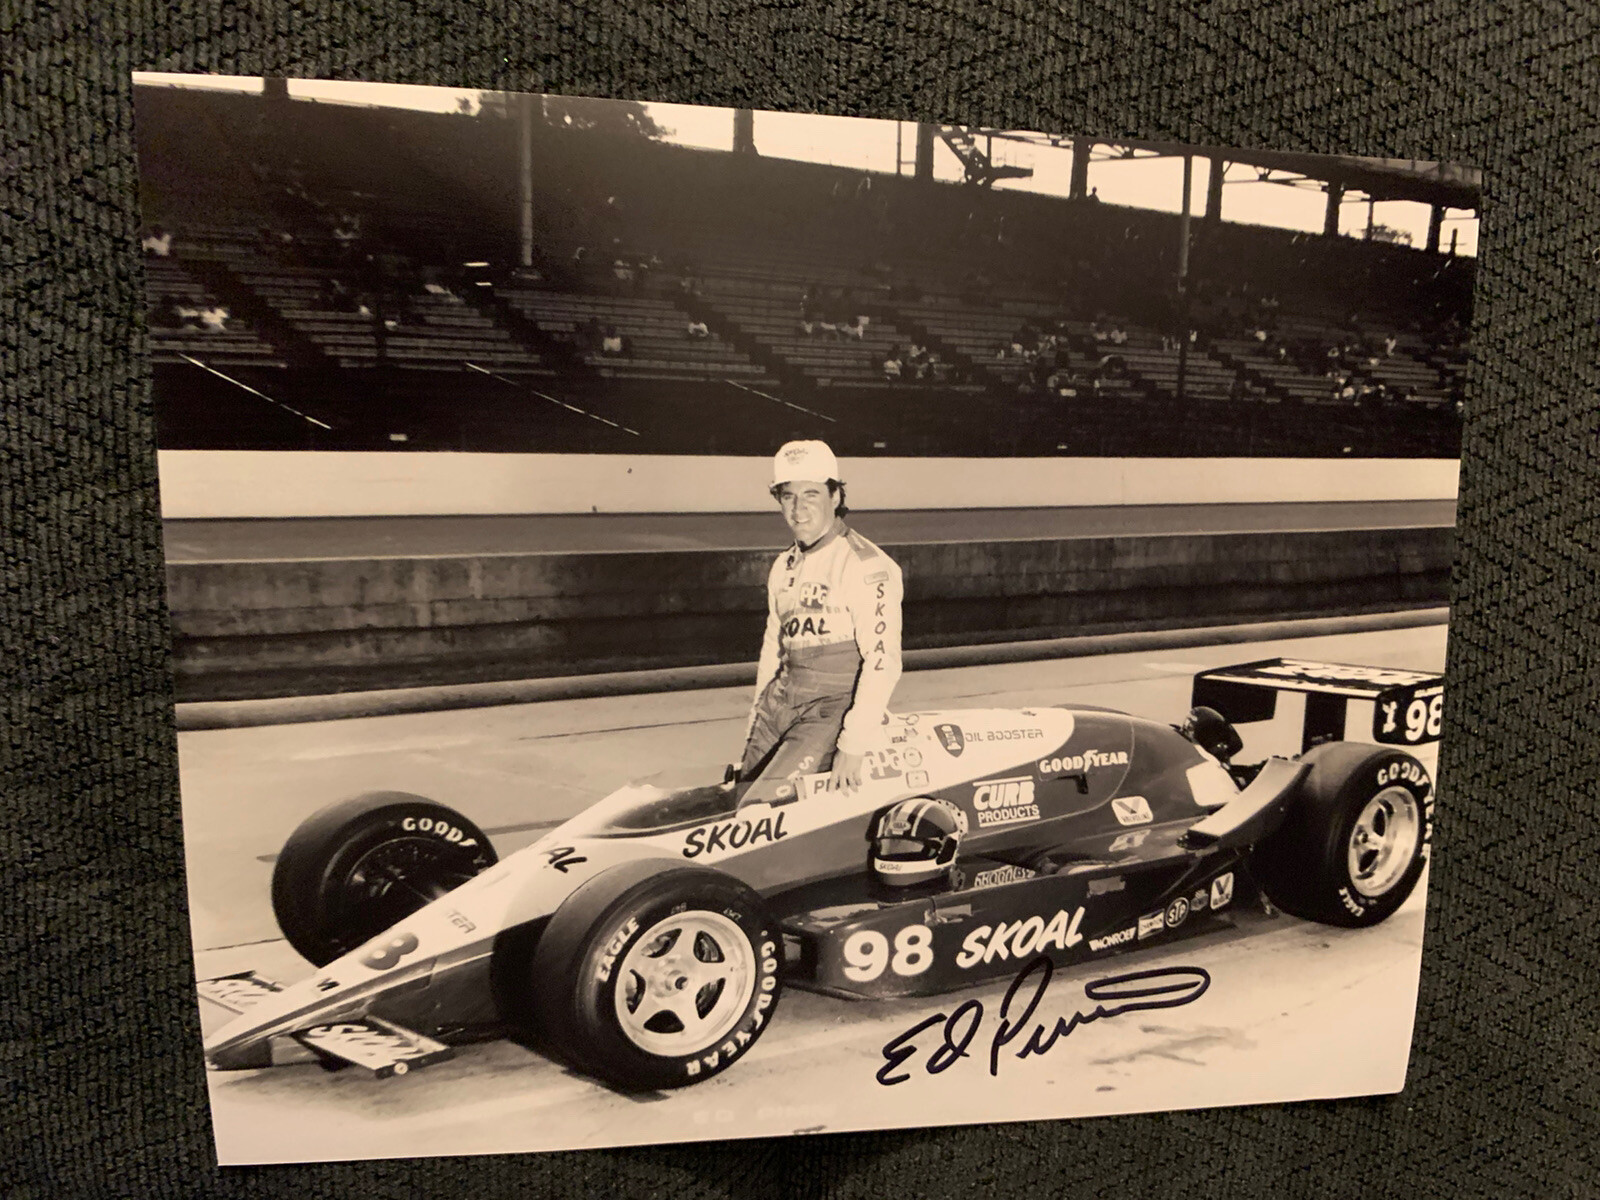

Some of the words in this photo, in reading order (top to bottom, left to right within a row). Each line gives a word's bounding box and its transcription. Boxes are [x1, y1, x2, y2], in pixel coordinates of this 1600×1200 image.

[874, 583, 886, 671] SKOAL
[965, 731, 984, 743] OIL
[986, 728, 1044, 742] BOOSTER
[1405, 694, 1443, 741] 98
[1039, 750, 1129, 774] GOODYEAR
[973, 780, 1036, 810] CURB
[977, 804, 1040, 823] PRODUCTS
[682, 811, 789, 858] SKOAL
[1168, 901, 1187, 923] STP
[596, 917, 640, 982] EAGLE
[843, 924, 934, 983] 98
[955, 906, 1087, 969] SKOAL
[685, 941, 777, 1076] GOODYEAR
[876, 999, 984, 1086] Ed
